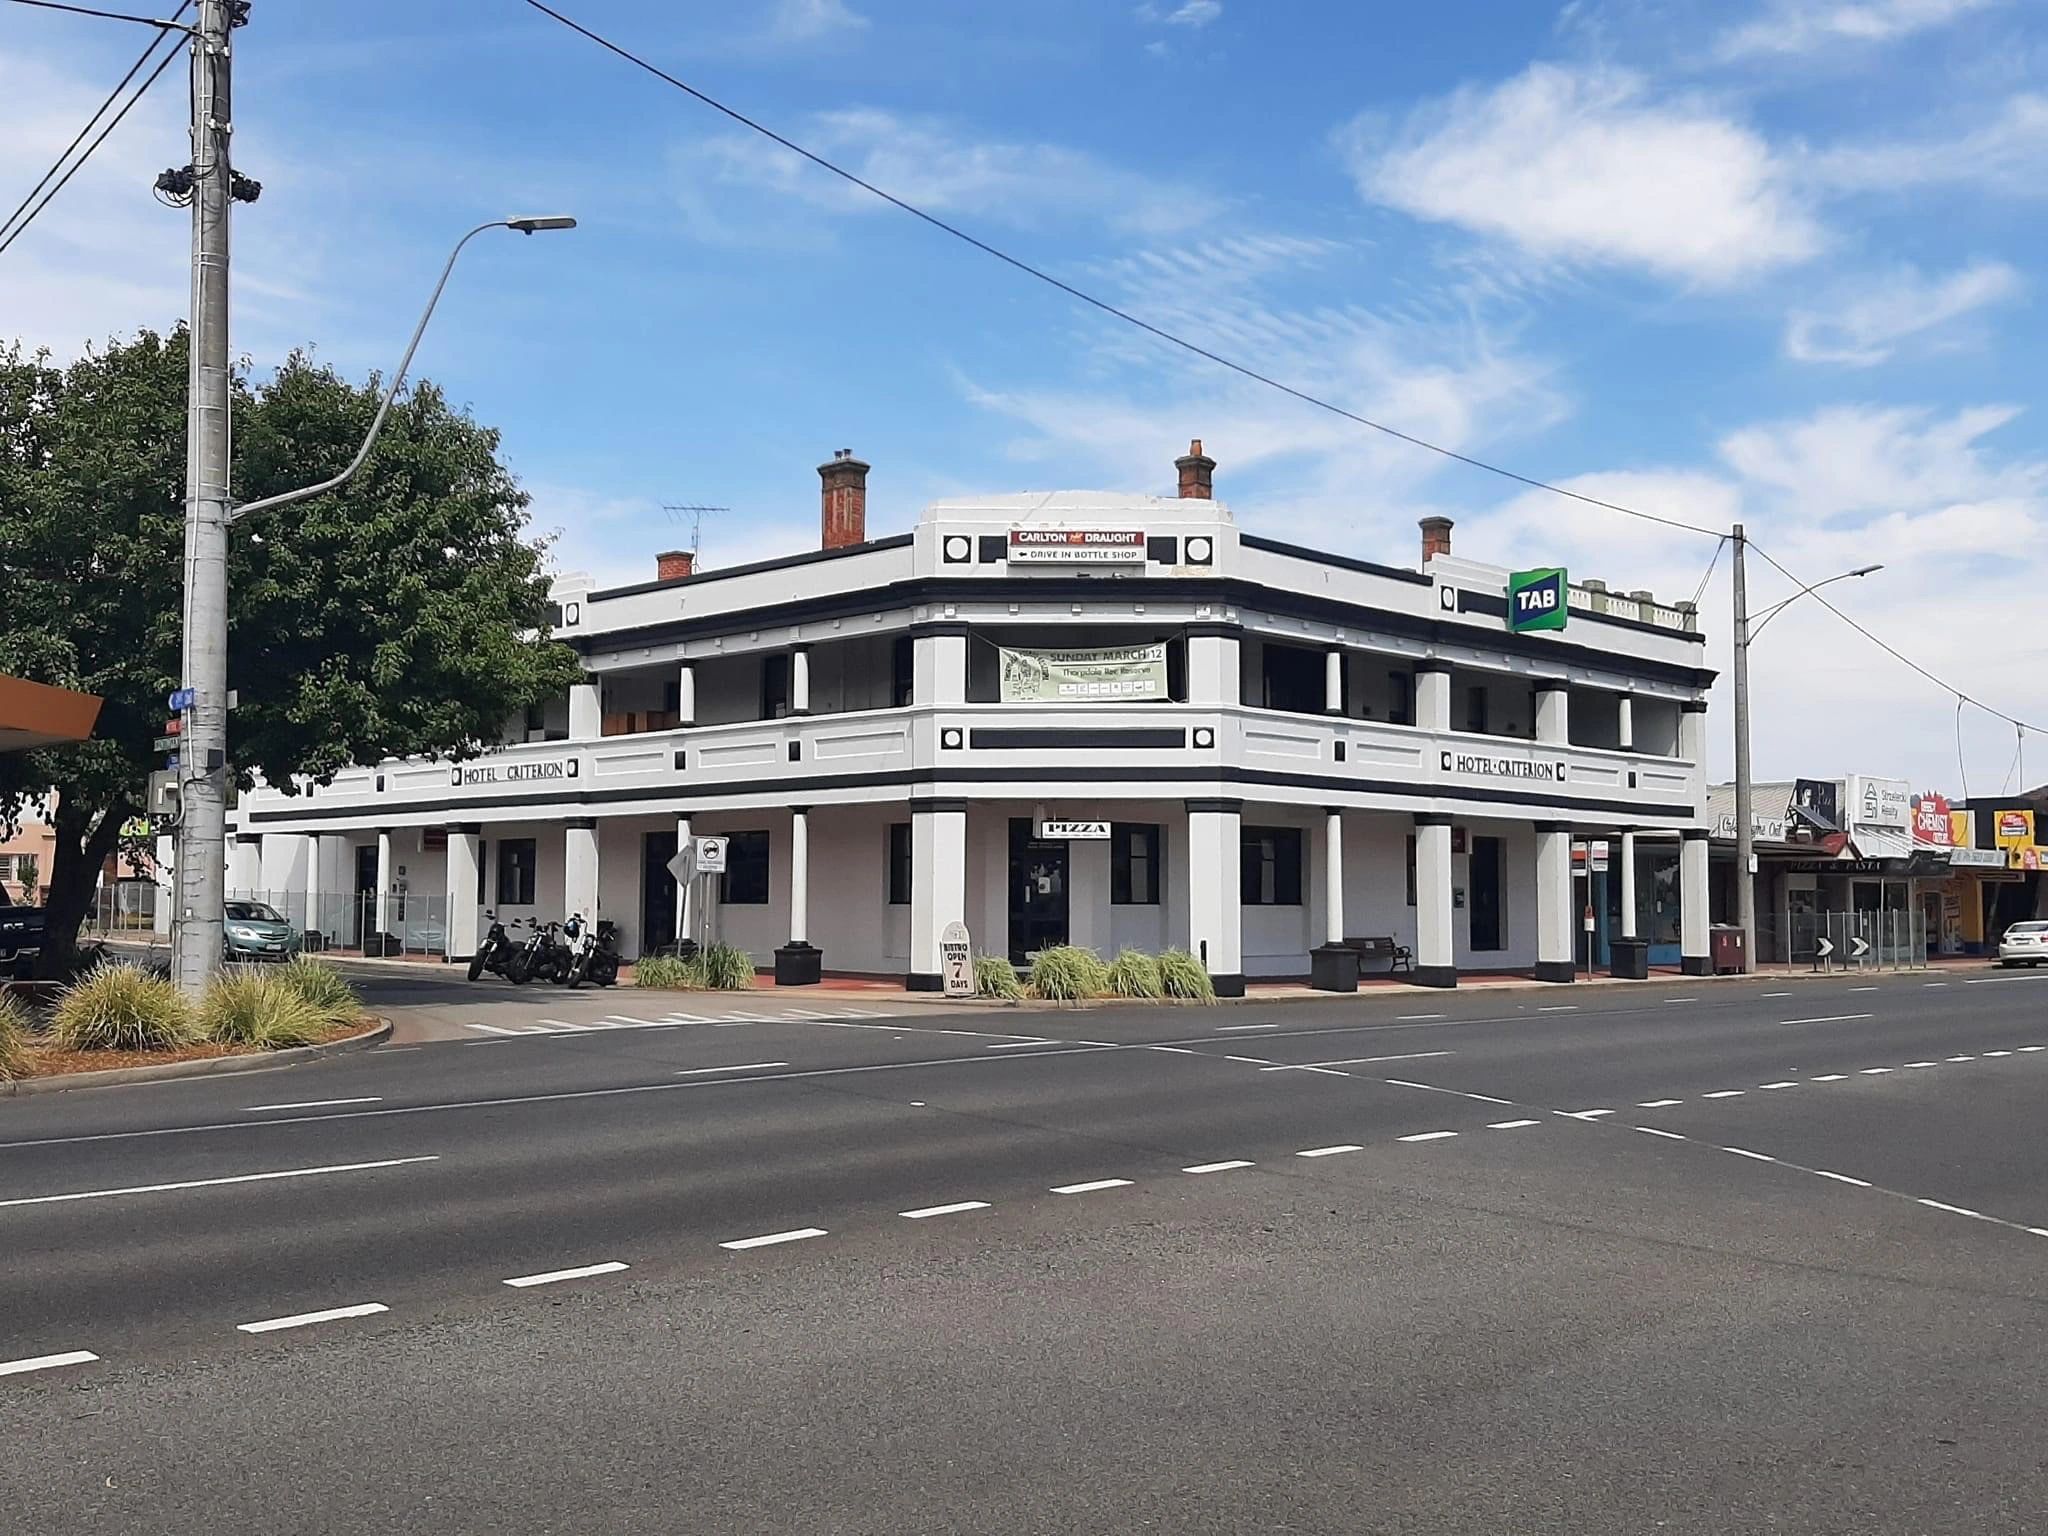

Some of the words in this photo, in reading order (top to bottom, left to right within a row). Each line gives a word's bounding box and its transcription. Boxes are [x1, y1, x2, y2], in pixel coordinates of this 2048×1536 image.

[1019, 532, 1067, 543] CARLTON
[1086, 532, 1137, 543] DRAUGHT
[1030, 551, 1058, 559] DRIVE
[1061, 551, 1071, 559] IN
[1074, 551, 1109, 559] BOTTLE
[1111, 550, 1137, 559] SHOP
[1517, 589, 1555, 611] TAB
[1050, 651, 1098, 662] SUNDAY
[1103, 649, 1146, 661] MARCH
[1151, 649, 1163, 659] 12
[464, 768, 498, 784] HOTEL
[507, 762, 563, 780] CRITERION
[1457, 755, 1493, 773] HOTEL
[1499, 760, 1553, 779] CRITERION
[1048, 823, 1106, 833] PIZZA
[1918, 812, 1948, 833] CHEMIST
[947, 953, 967, 961] OPEN
[952, 962, 963, 979] 7
[951, 980, 968, 989] DAYS
